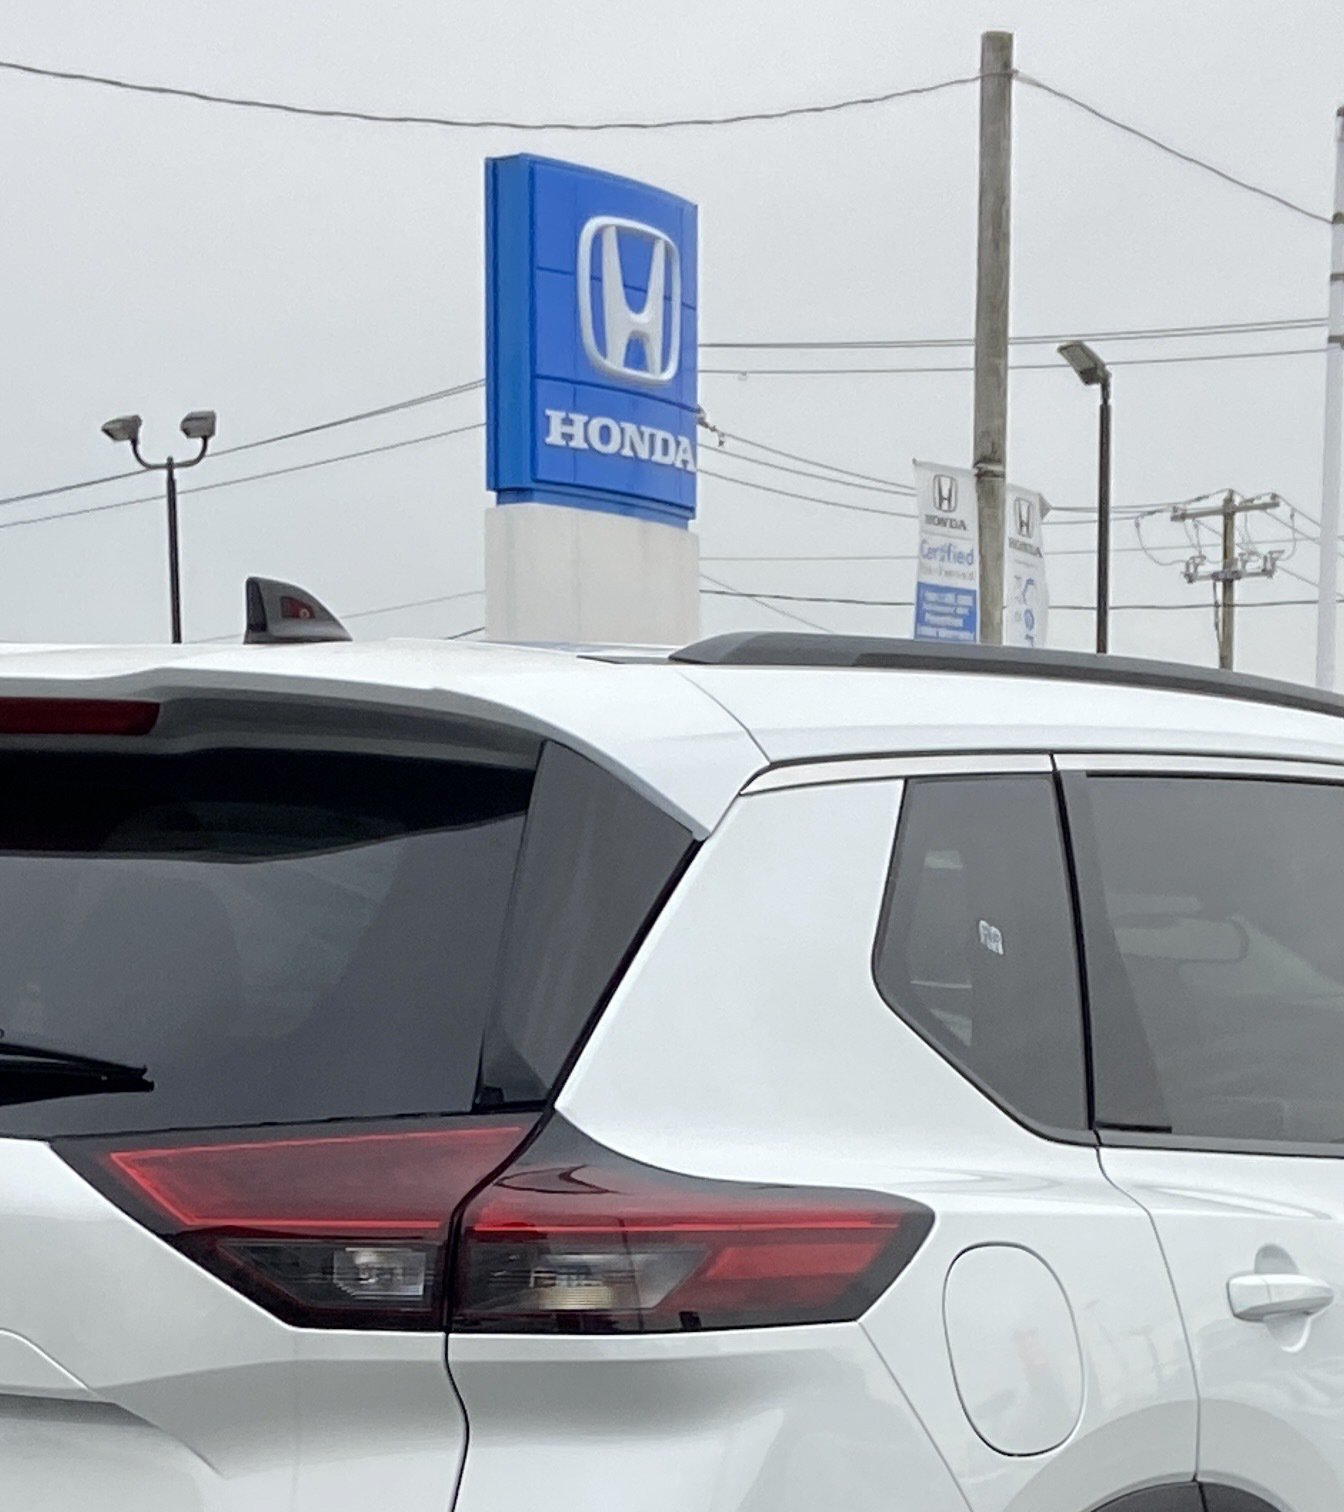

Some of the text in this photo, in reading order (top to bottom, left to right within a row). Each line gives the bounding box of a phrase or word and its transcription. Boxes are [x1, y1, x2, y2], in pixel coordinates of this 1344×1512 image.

[544, 408, 697, 474] HONDA
[924, 514, 967, 531] HONDA
[920, 538, 974, 566] Certified
